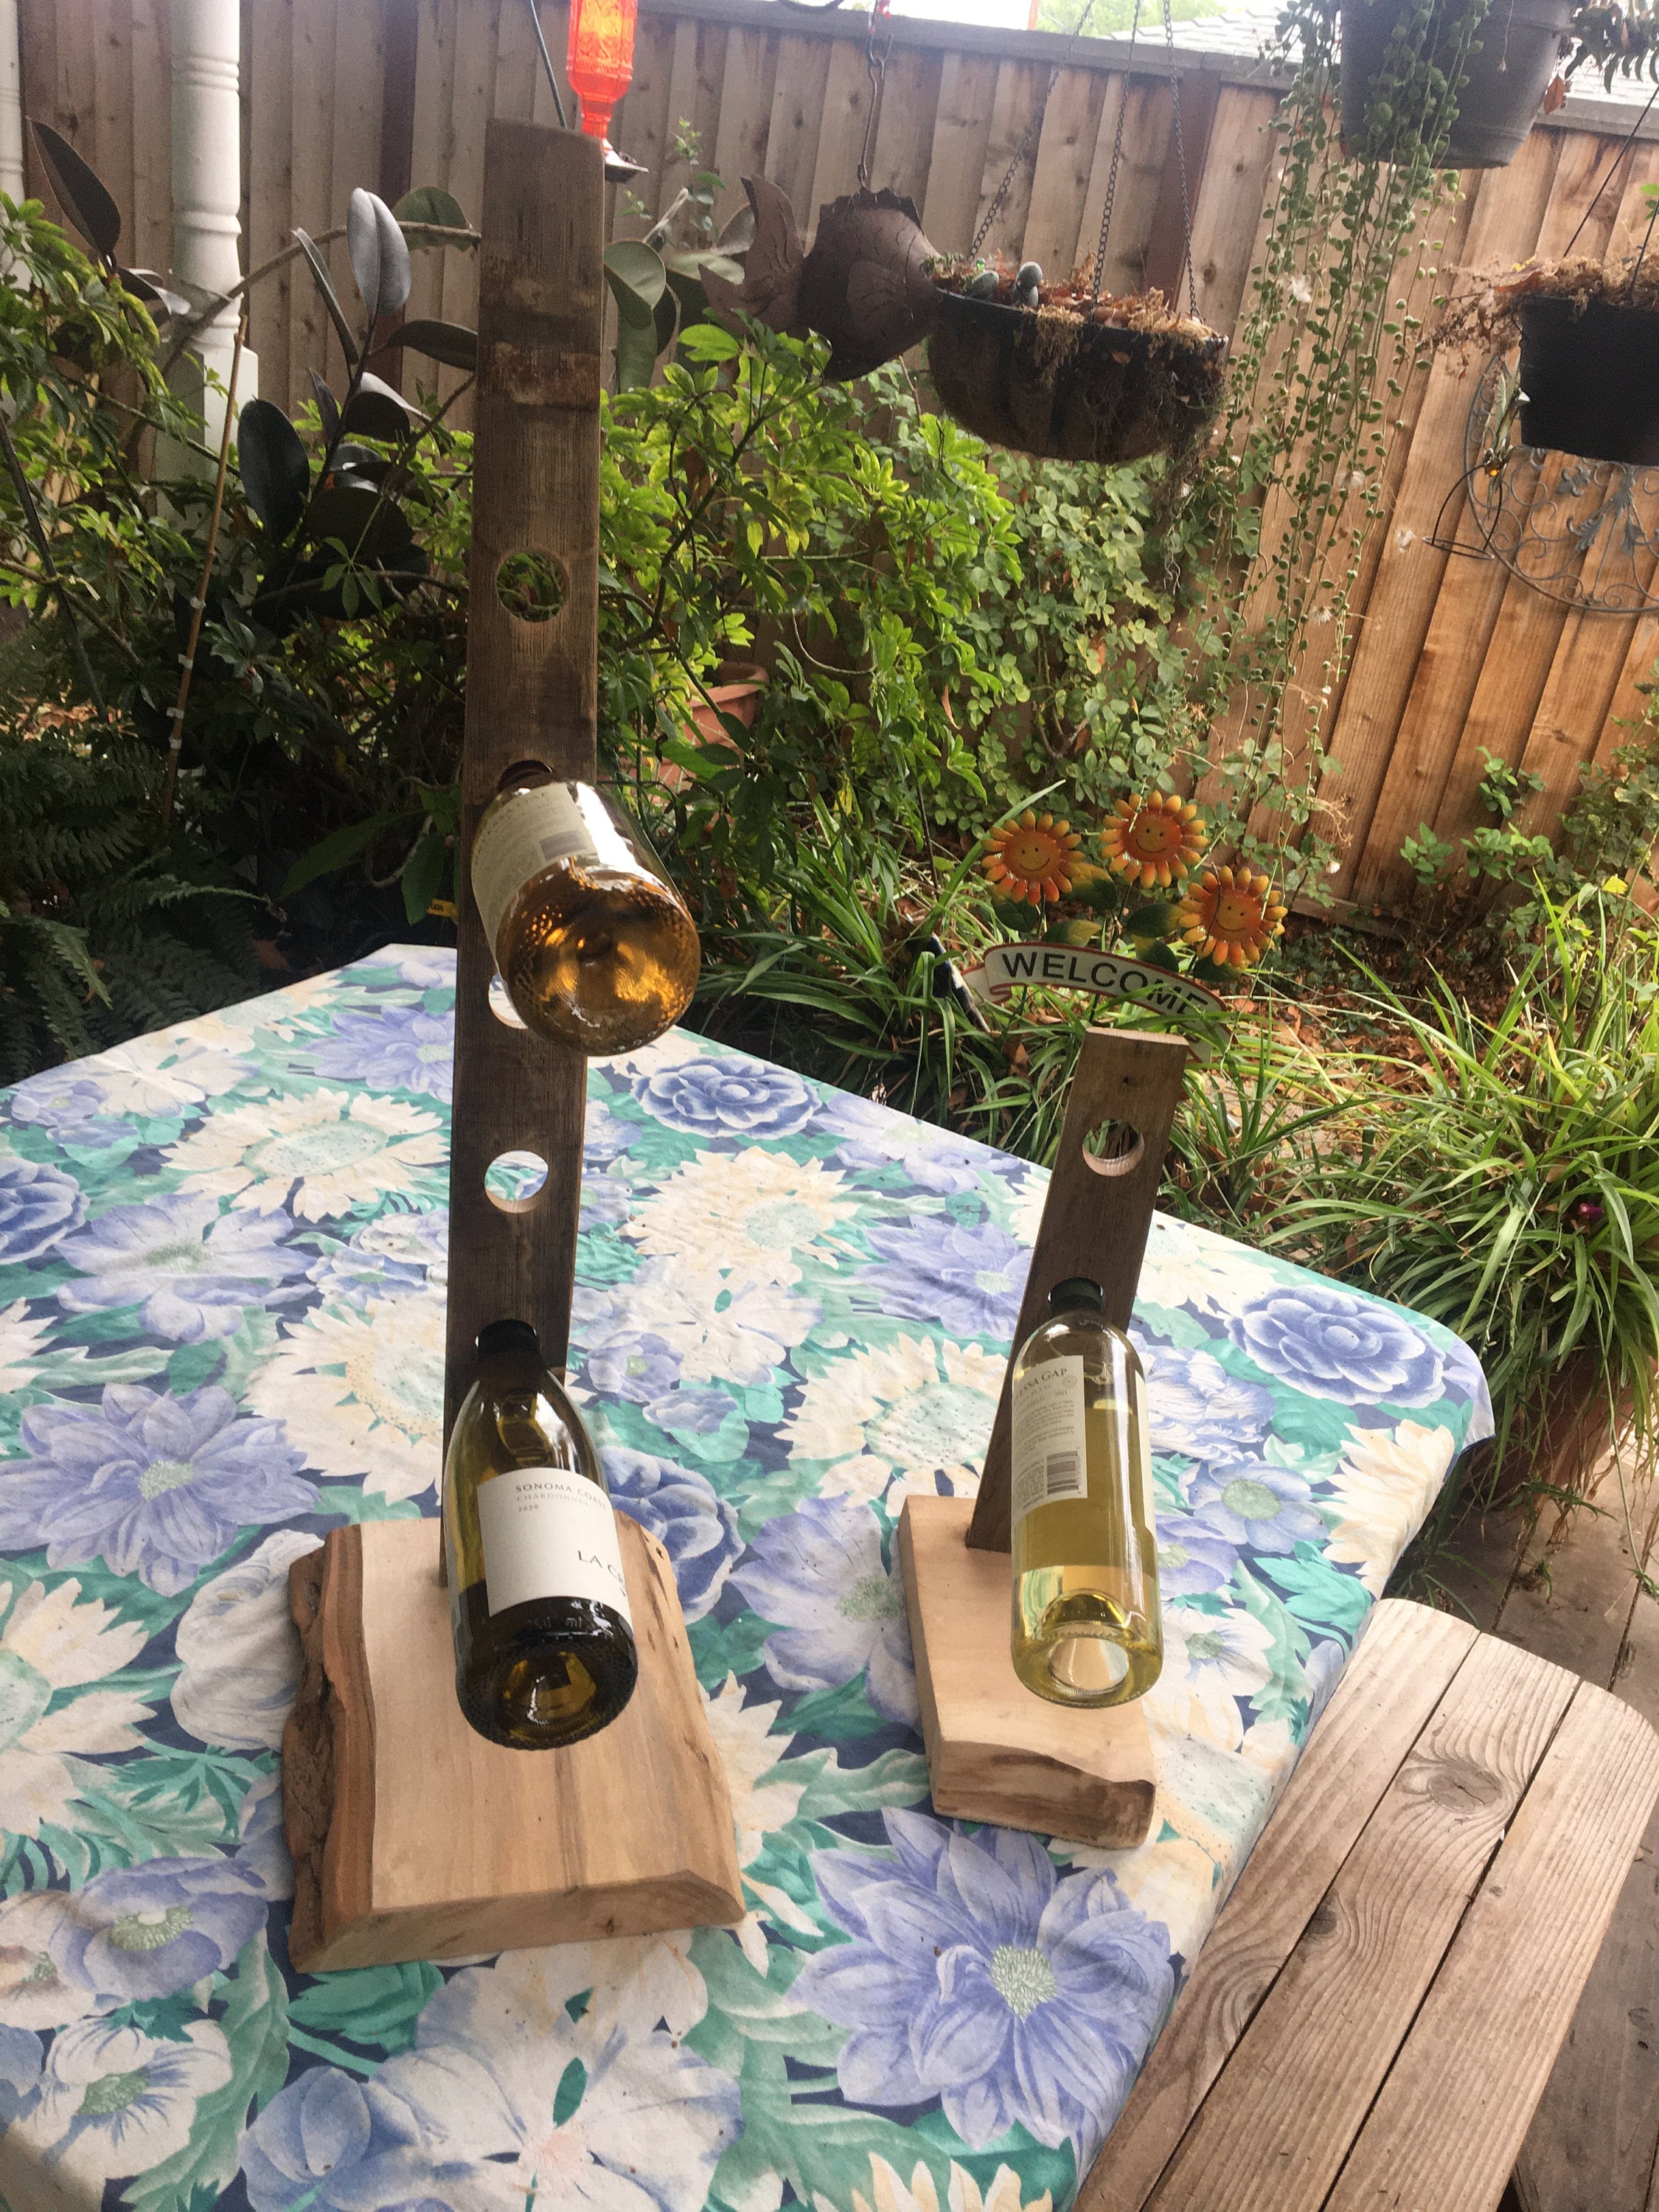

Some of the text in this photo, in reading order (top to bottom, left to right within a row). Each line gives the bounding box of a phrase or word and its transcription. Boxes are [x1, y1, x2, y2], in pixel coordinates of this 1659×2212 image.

[1041, 1368, 1068, 1381] GAP
[515, 1482, 607, 1510] SONOMA COAST
[516, 1492, 589, 1506] CHARDONNAY
[577, 1550, 603, 1569] LA
